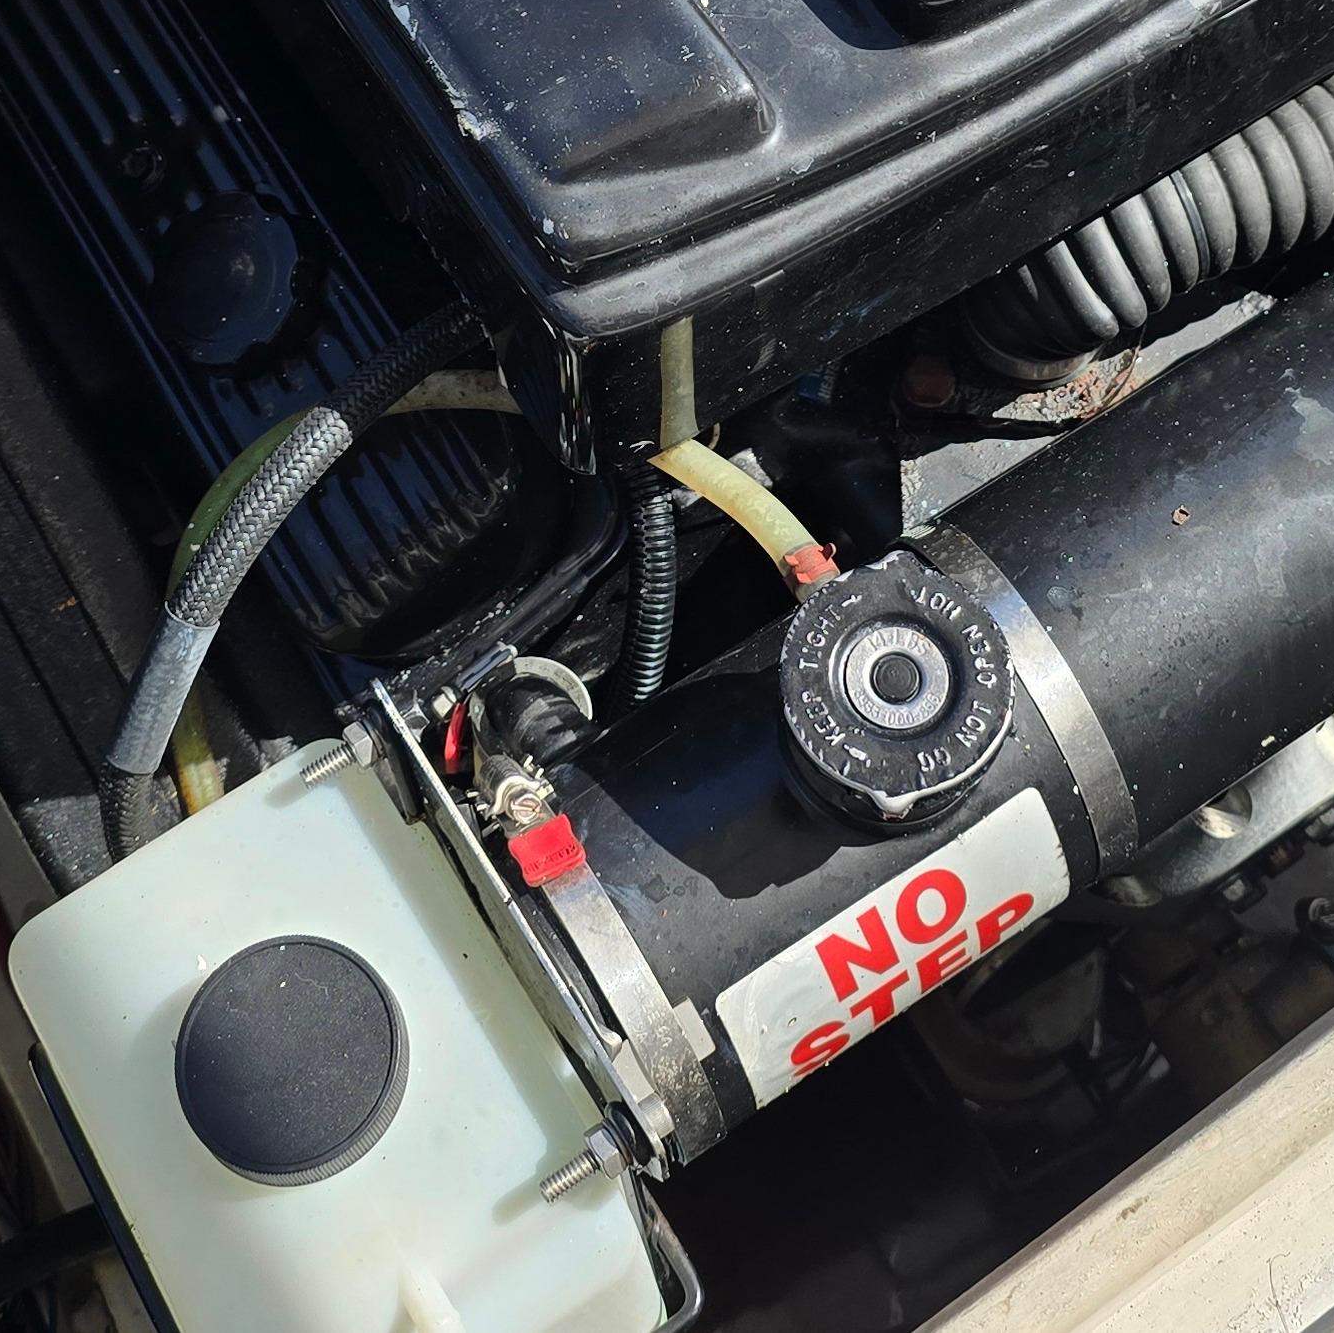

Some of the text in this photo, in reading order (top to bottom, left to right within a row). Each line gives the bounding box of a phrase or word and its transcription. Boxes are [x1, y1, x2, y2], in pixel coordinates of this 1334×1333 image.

[914, 586, 962, 621] HOT
[799, 604, 845, 746] KEEP TIGHT
[961, 624, 997, 689] OPEN
[955, 700, 992, 748] NOT
[790, 893, 1034, 1077] STEP
[815, 869, 967, 1003] NO
